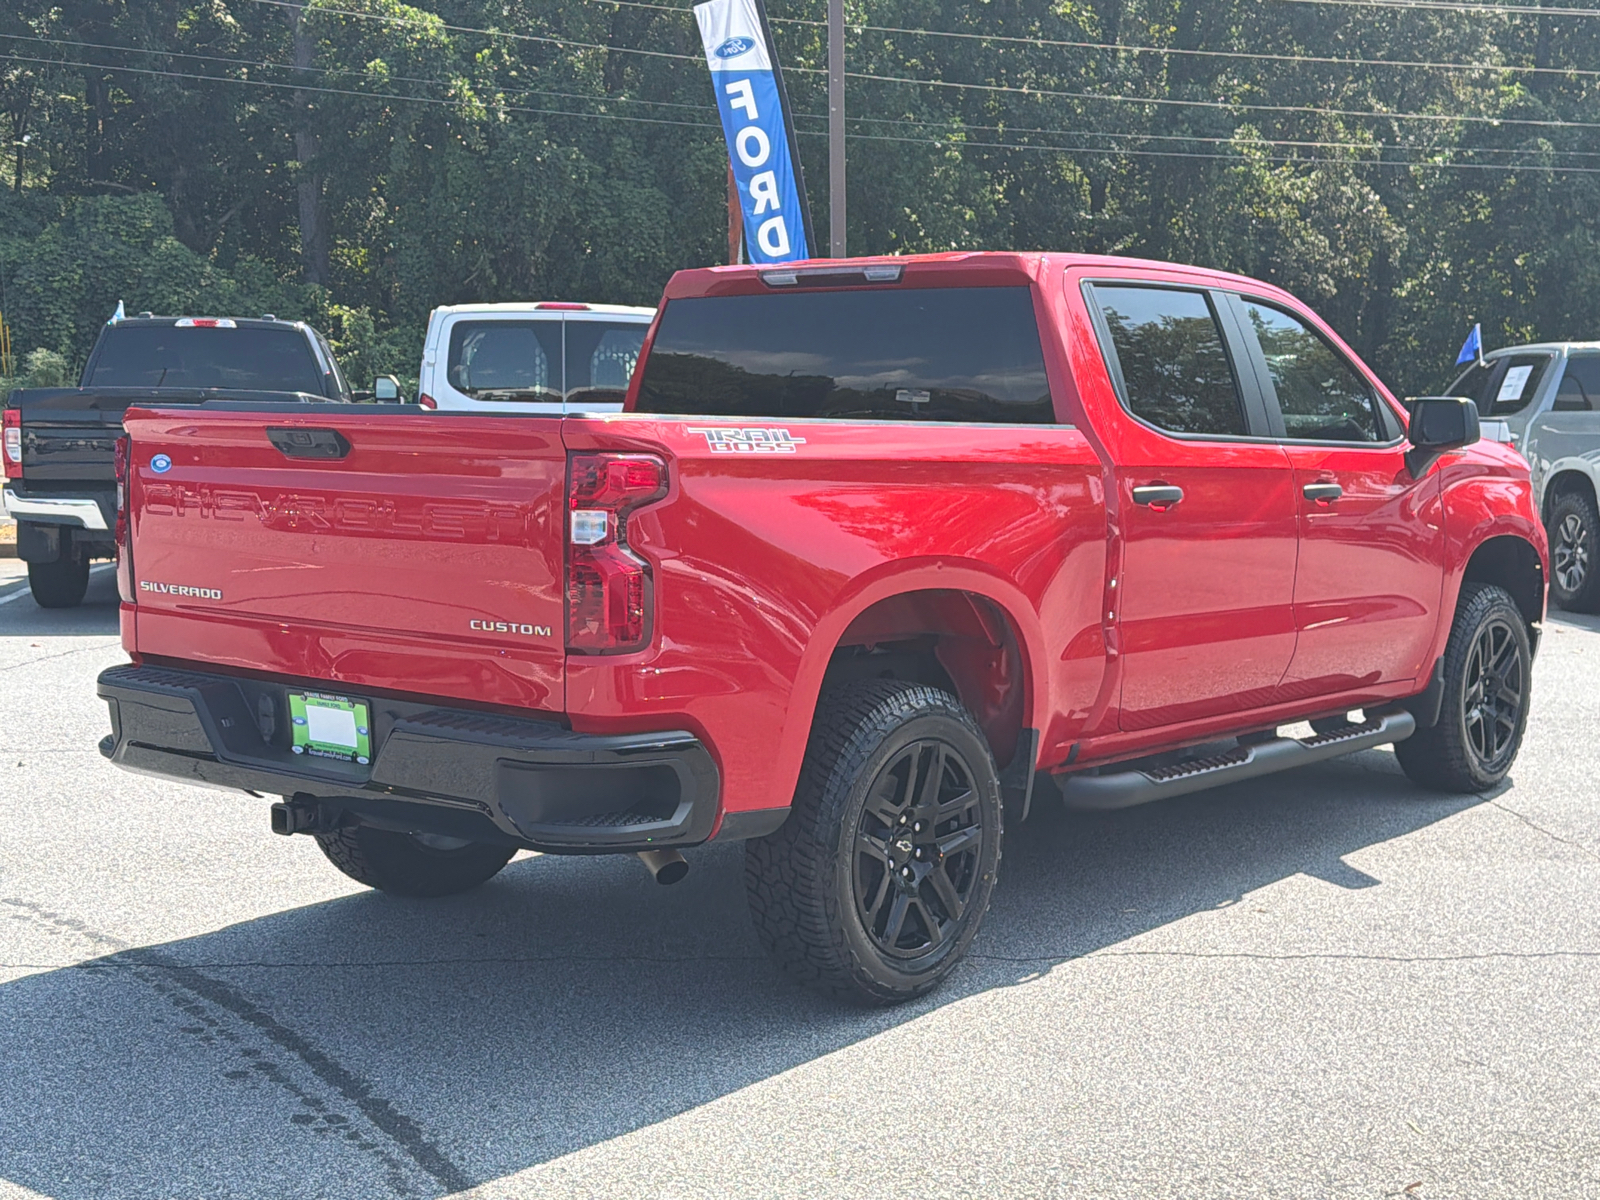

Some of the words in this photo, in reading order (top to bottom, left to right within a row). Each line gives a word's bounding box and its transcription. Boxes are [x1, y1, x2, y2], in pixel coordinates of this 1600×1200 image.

[687, 427, 807, 444] TRAIL
[709, 441, 797, 454] BOSS
[143, 484, 525, 540] CHEVROLET
[140, 581, 222, 600] SILVERADO
[470, 619, 551, 637] CUSTOM
